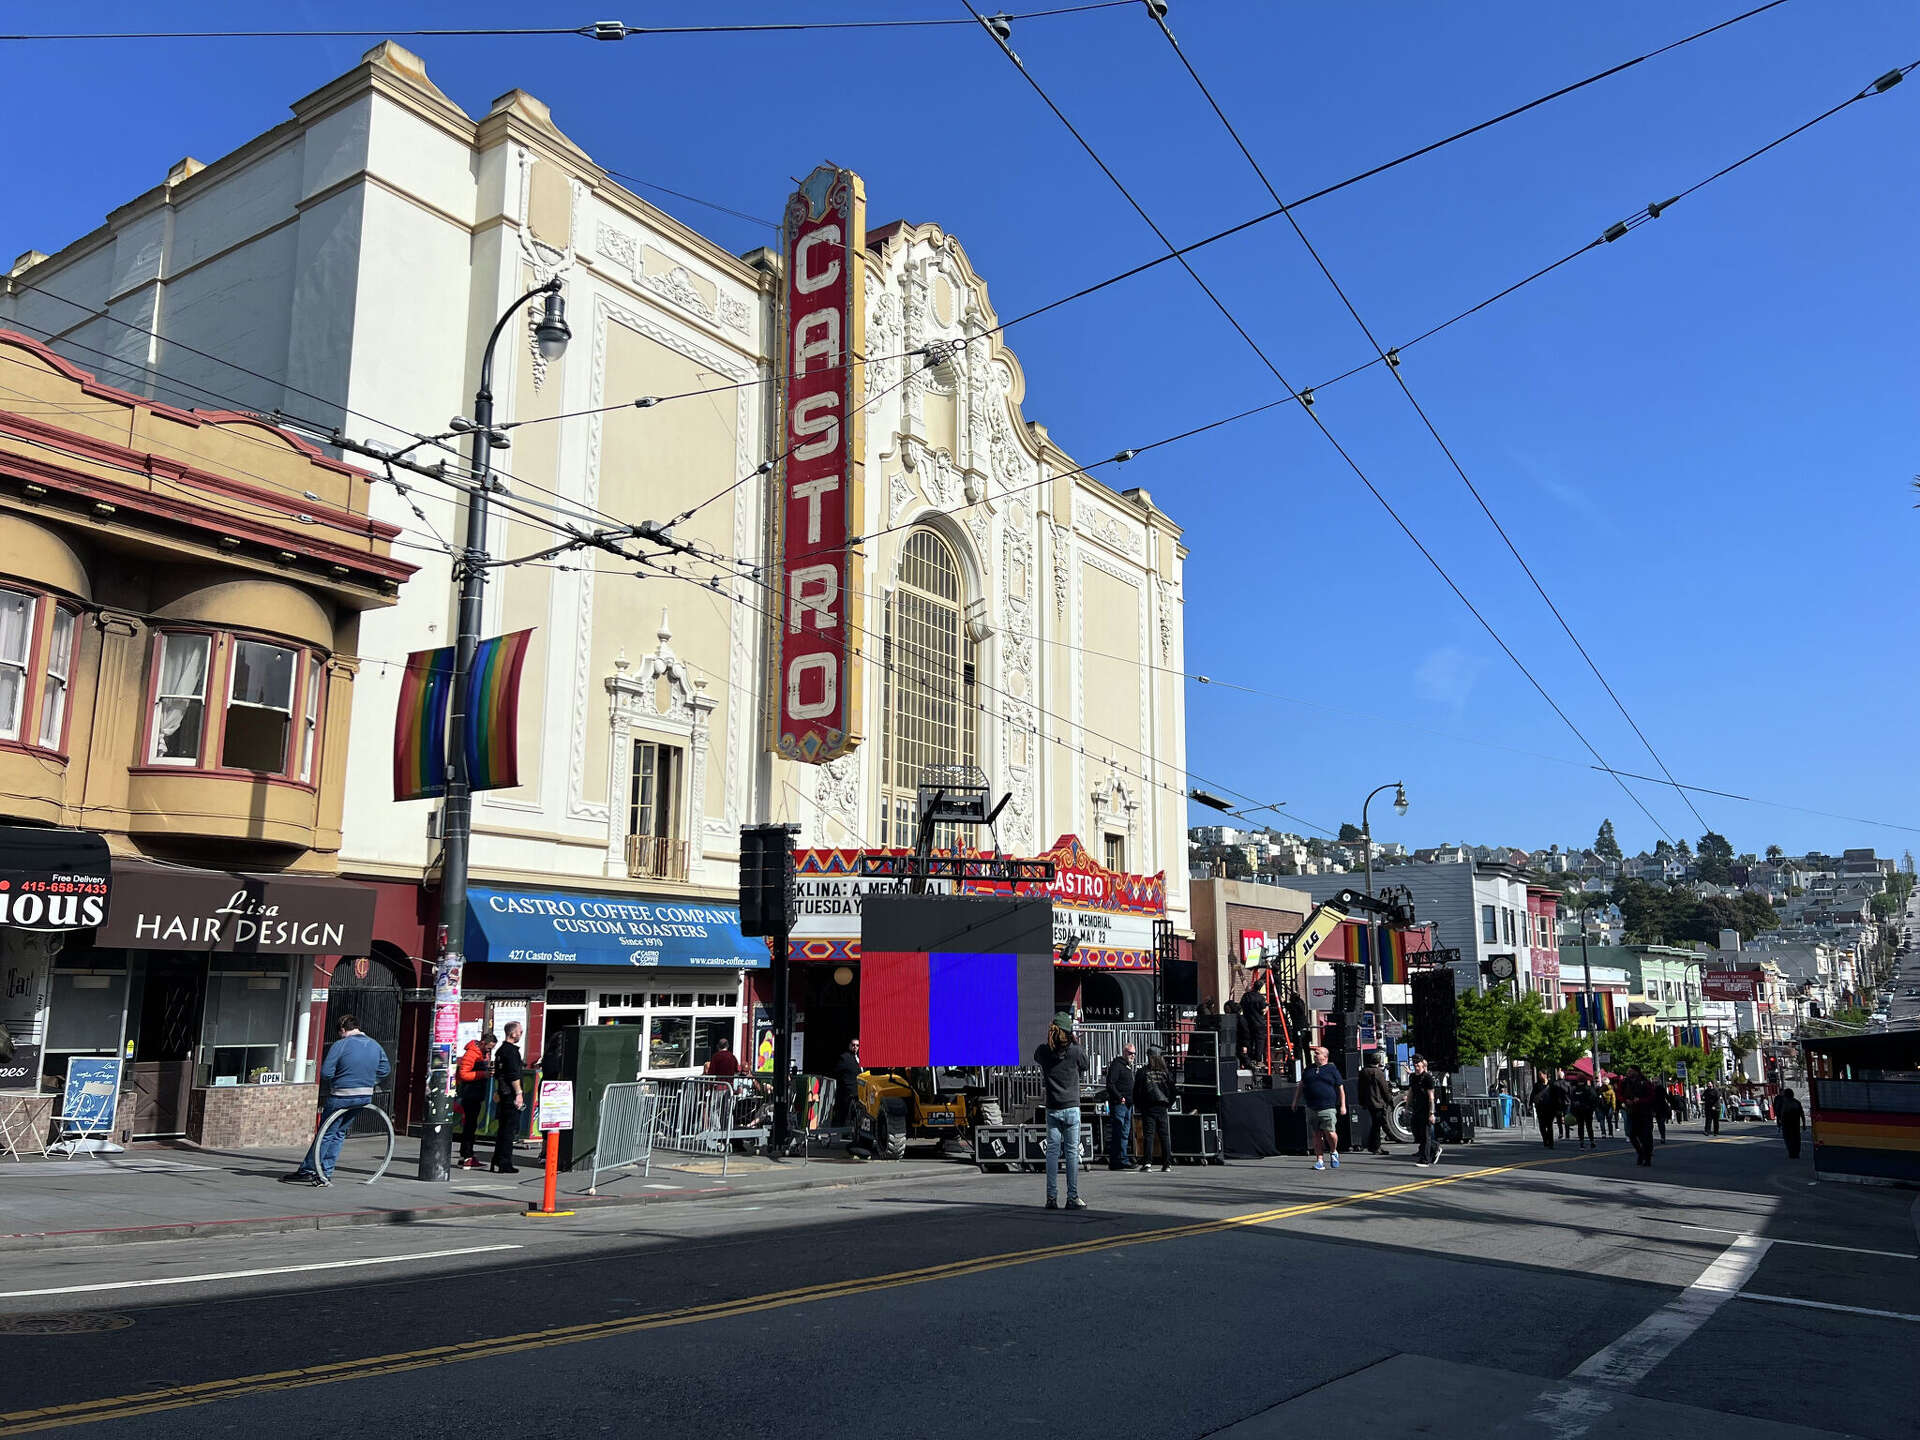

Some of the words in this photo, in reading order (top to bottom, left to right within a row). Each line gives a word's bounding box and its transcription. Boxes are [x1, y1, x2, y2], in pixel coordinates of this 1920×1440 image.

[787, 223, 842, 721] CASTRO
[52, 873, 71, 882] Free
[73, 874, 105, 885] Delivery
[21, 880, 107, 894] 415-658-7433
[852, 882, 861, 896] A
[868, 882, 946, 896] MEMAL
[215, 890, 280, 917] Lisa
[489, 896, 576, 917] CASTRO
[580, 902, 654, 921] COFFEE
[655, 907, 739, 925] COMPANY
[792, 899, 863, 914] TUESDAY
[552, 918, 627, 935] CUSTOM
[628, 922, 708, 939] ROASTERS
[1078, 913, 1112, 929] MEMORIAL
[135, 913, 222, 943] HAIR
[235, 919, 345, 947] DESIGN
[1080, 928, 1096, 943] MAY
[1098, 930, 1106, 944] 23
[619, 936, 644, 947] Since
[644, 937, 664, 947] 1970
[1302, 930, 1320, 957] JLG
[508, 949, 525, 960] 427
[525, 950, 553, 961] Castro
[553, 951, 577, 962] Street
[690, 956, 758, 966] www.castro-coffee.com
[1086, 1006, 1121, 1015] NAILS
[262, 1074, 280, 1083] OPEN
